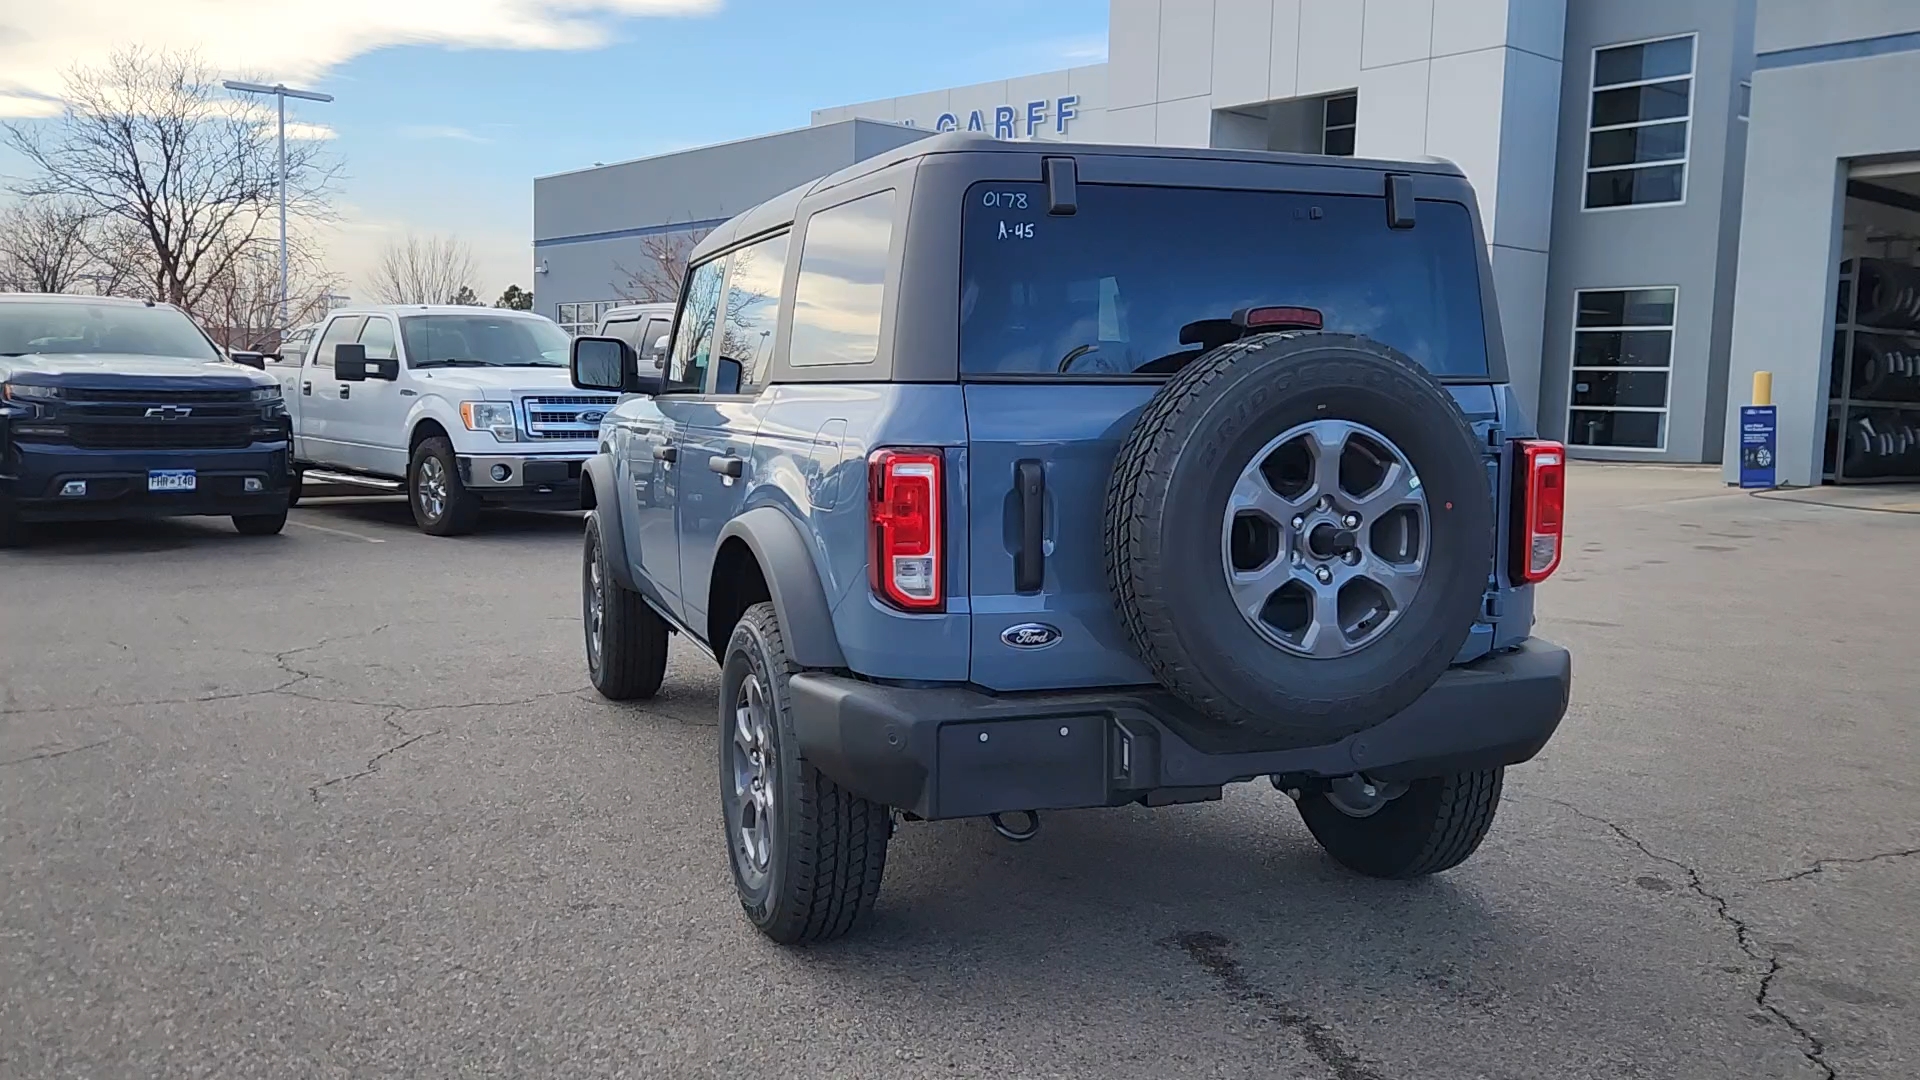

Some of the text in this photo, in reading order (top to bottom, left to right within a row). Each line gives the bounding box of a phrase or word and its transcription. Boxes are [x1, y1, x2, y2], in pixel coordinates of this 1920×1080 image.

[936, 95, 1077, 140] GARFF
[983, 191, 1028, 209] 0178
[998, 220, 1035, 240] A-45
[1015, 628, 1049, 644] Ford
